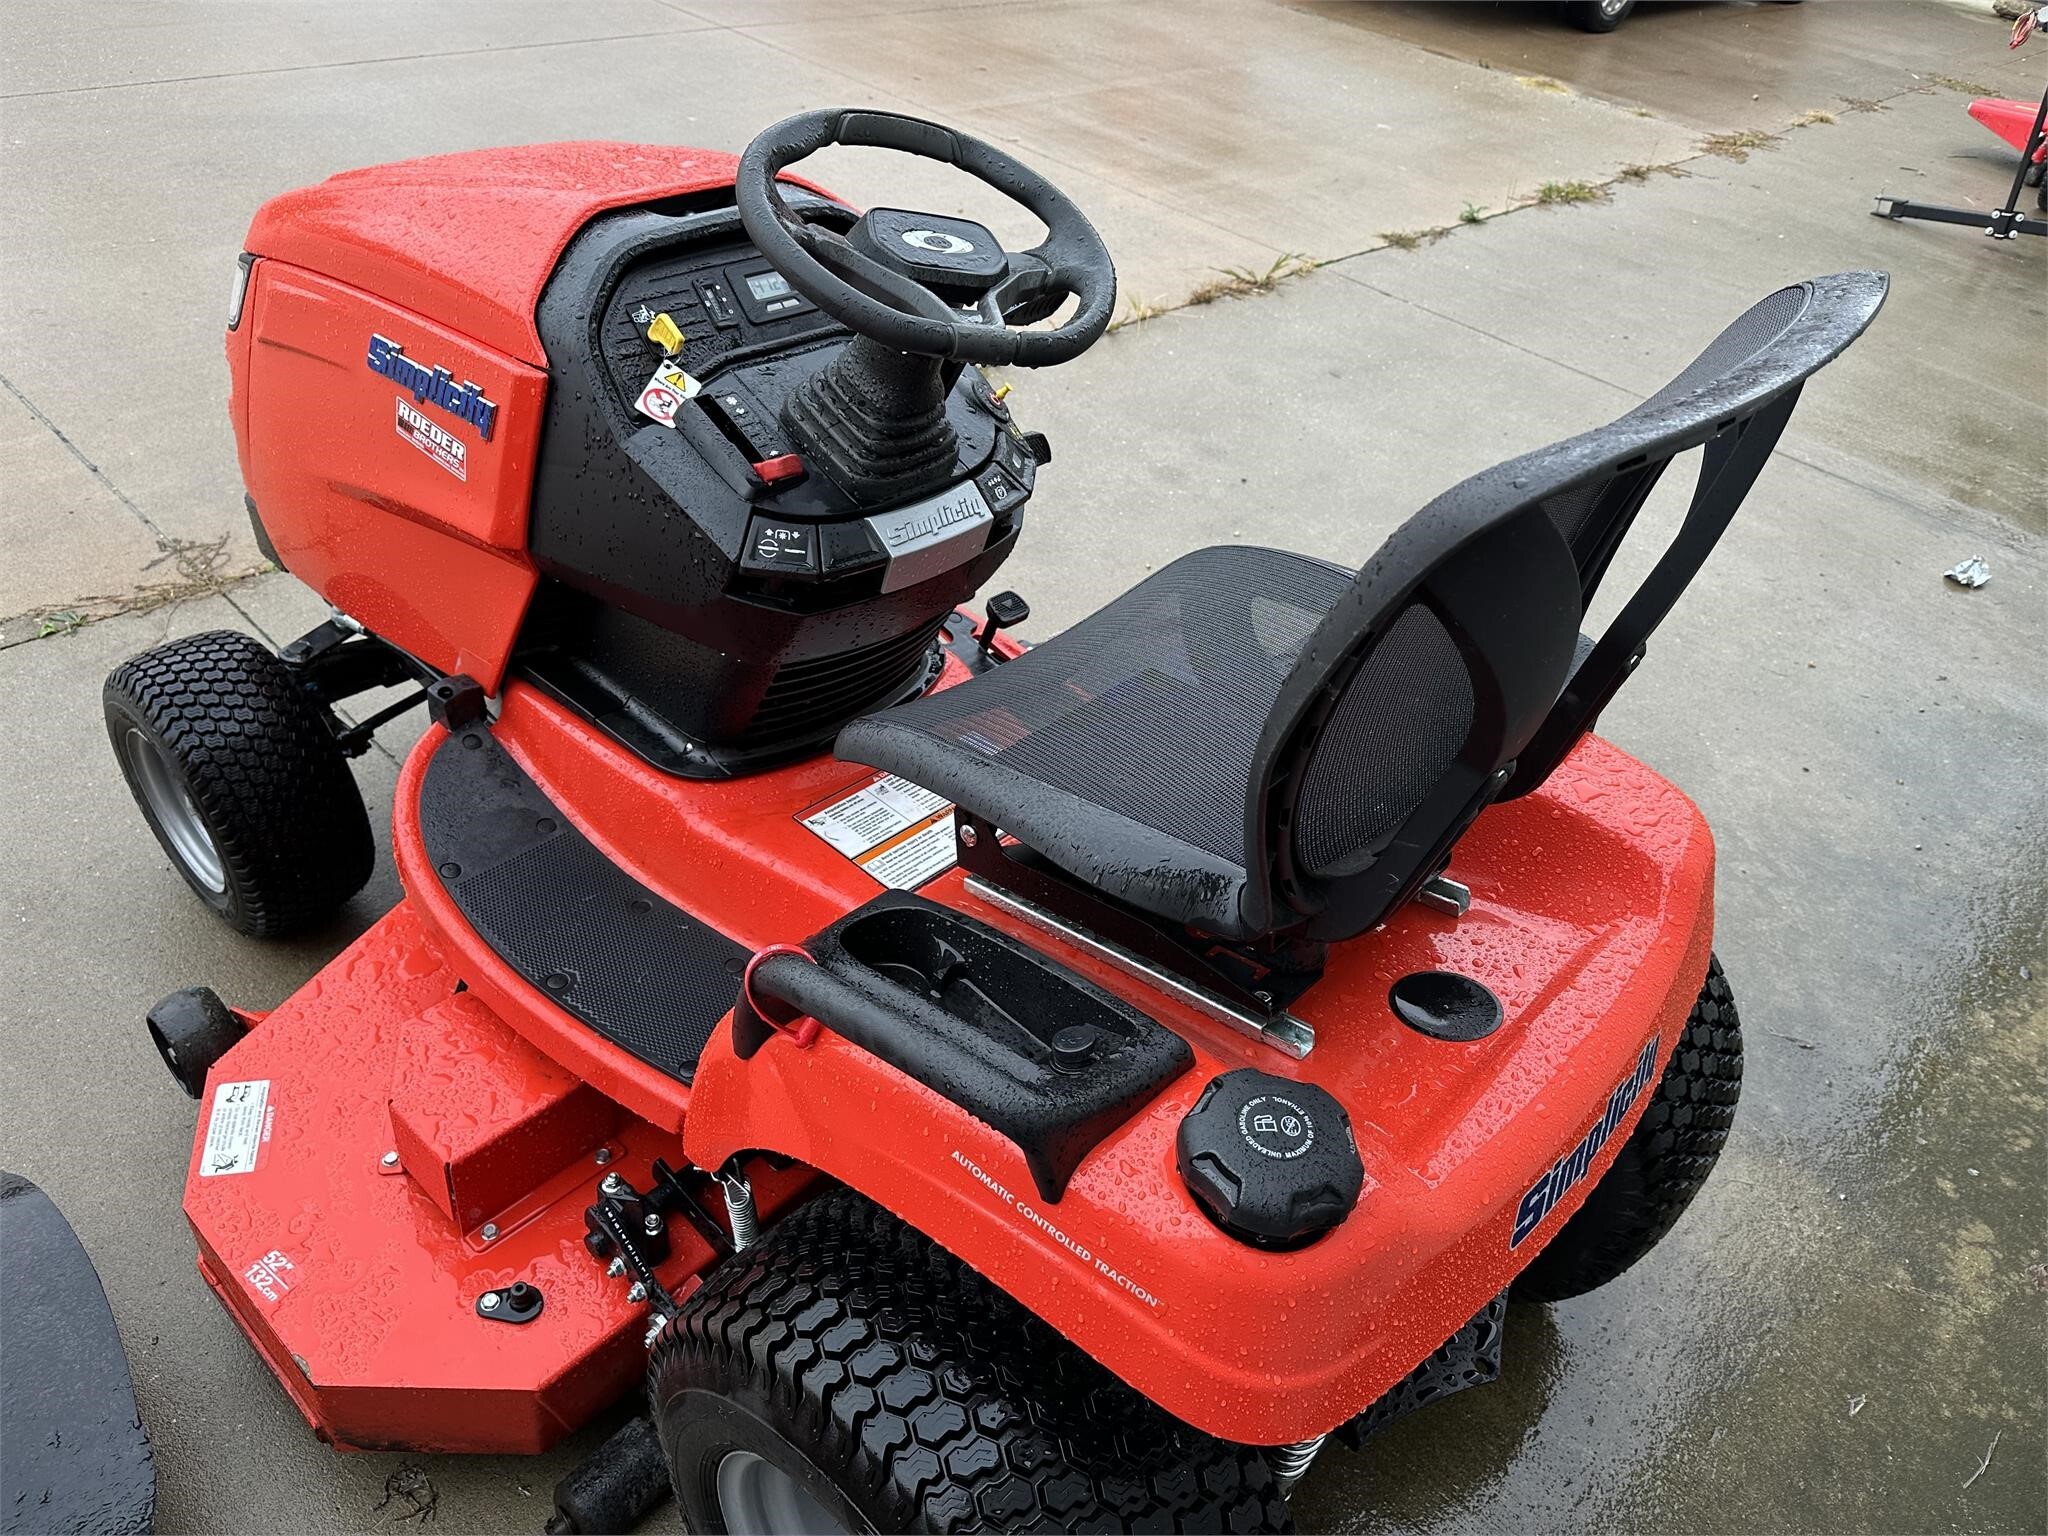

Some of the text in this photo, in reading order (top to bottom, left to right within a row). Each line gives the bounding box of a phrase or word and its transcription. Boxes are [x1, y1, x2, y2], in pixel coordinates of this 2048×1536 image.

[367, 333, 497, 442] Simplicity
[398, 401, 465, 462] ROEDER
[413, 430, 460, 469] BROTHERS
[887, 498, 985, 547] Simplicity
[261, 1112, 274, 1142] DANGER
[1239, 1096, 1282, 1159] UNLEADED GASOLINE ONLY
[1272, 1096, 1305, 1116] ETHANOL
[1285, 1139, 1312, 1158] MAXIMUM
[1510, 1031, 1661, 1251] Simplicity
[951, 1150, 1015, 1204] AUTOMATIC
[1016, 1201, 1091, 1261] CONTROLLED
